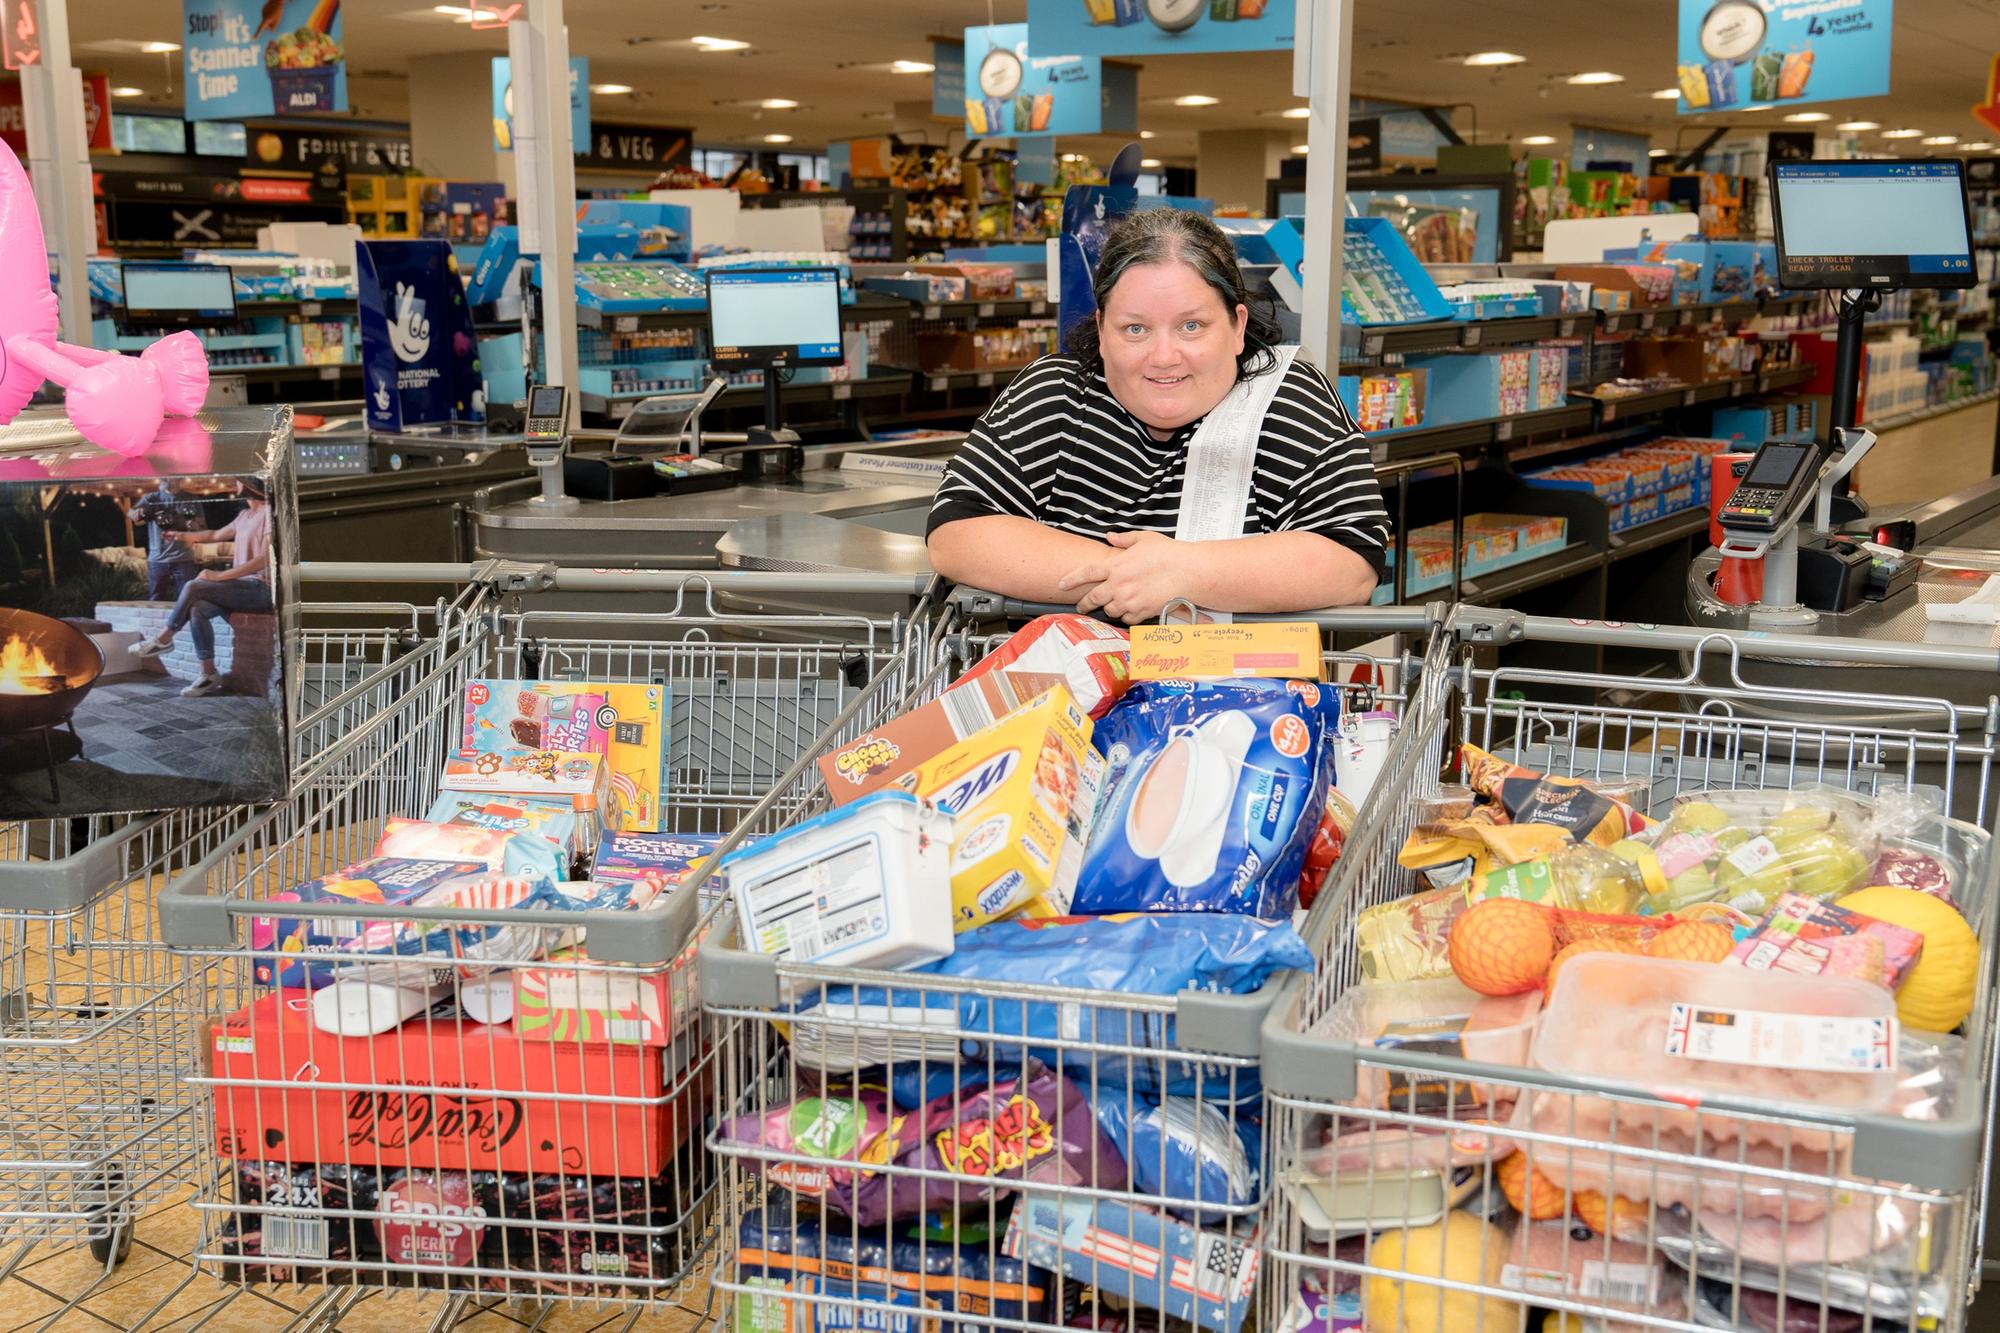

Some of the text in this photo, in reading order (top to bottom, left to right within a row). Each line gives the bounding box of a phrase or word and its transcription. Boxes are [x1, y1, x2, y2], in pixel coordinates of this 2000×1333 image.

[223, 14, 250, 44] It's
[1808, 11, 1866, 36] 4 years
[189, 45, 261, 74] Scanner
[197, 73, 238, 101] time
[289, 92, 317, 106] ALDI
[366, 142, 381, 166] &
[601, 136, 655, 161] & VEG
[1787, 256, 1814, 264] CHECK
[1819, 256, 1855, 264] TROLLEY
[1788, 264, 1815, 272] READY
[1829, 264, 1852, 272] SCAN
[1942, 259, 1968, 268] 0.00
[820, 346, 839, 354] 0.00
[397, 368, 441, 380] NATIONAL
[859, 457, 885, 469] Please
[886, 459, 924, 472] Customer
[1134, 653, 1191, 673] Kellogg's
[470, 686, 482, 702] 12
[1276, 717, 1299, 752] 440
[838, 741, 888, 769] CHOCO
[1266, 784, 1285, 823] ONE CUP
[612, 844, 699, 858] LOLLIES
[614, 837, 705, 851] ROCKET
[1230, 850, 1263, 899] Tetley
[220, 1136, 248, 1155] 18
[373, 1190, 488, 1237] Tango
[401, 1234, 457, 1252] CHERRY
